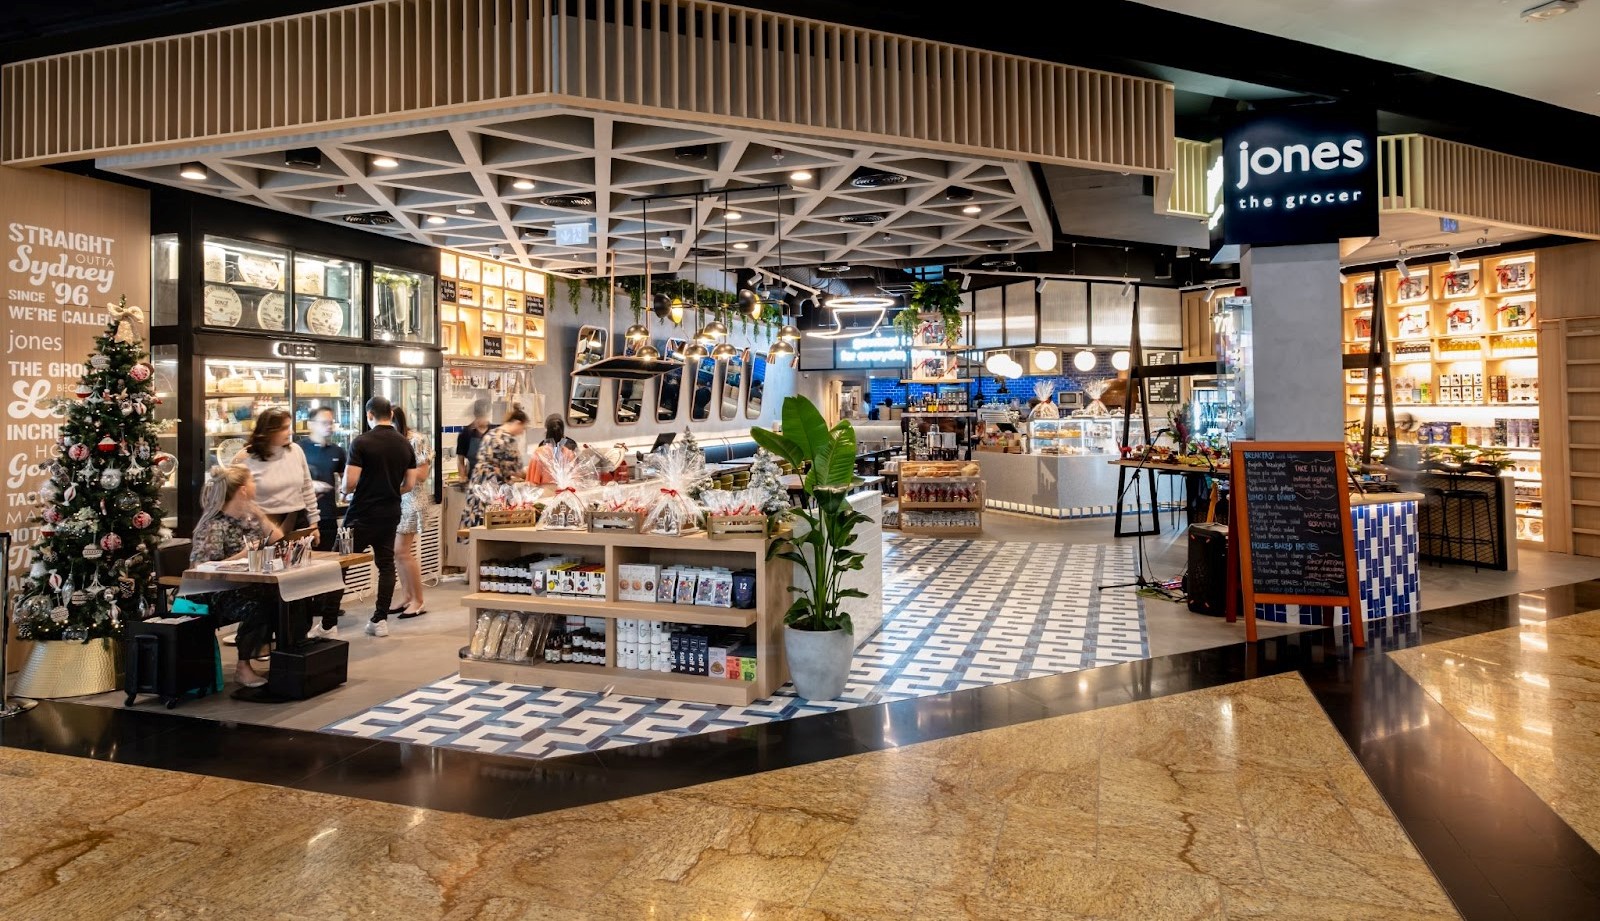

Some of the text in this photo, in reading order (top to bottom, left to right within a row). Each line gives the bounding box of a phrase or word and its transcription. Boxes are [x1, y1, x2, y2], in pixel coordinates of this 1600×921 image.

[1236, 139, 1364, 190] jones
[1239, 190, 1362, 209] the grocer
[8, 222, 115, 256] STRAIGHT
[8, 244, 115, 294] Sydney
[75, 254, 115, 268] OUTTA
[8, 289, 46, 303] SINCE
[8, 305, 57, 323] WE'RE
[7, 330, 63, 354] jones
[8, 361, 43, 377] THE
